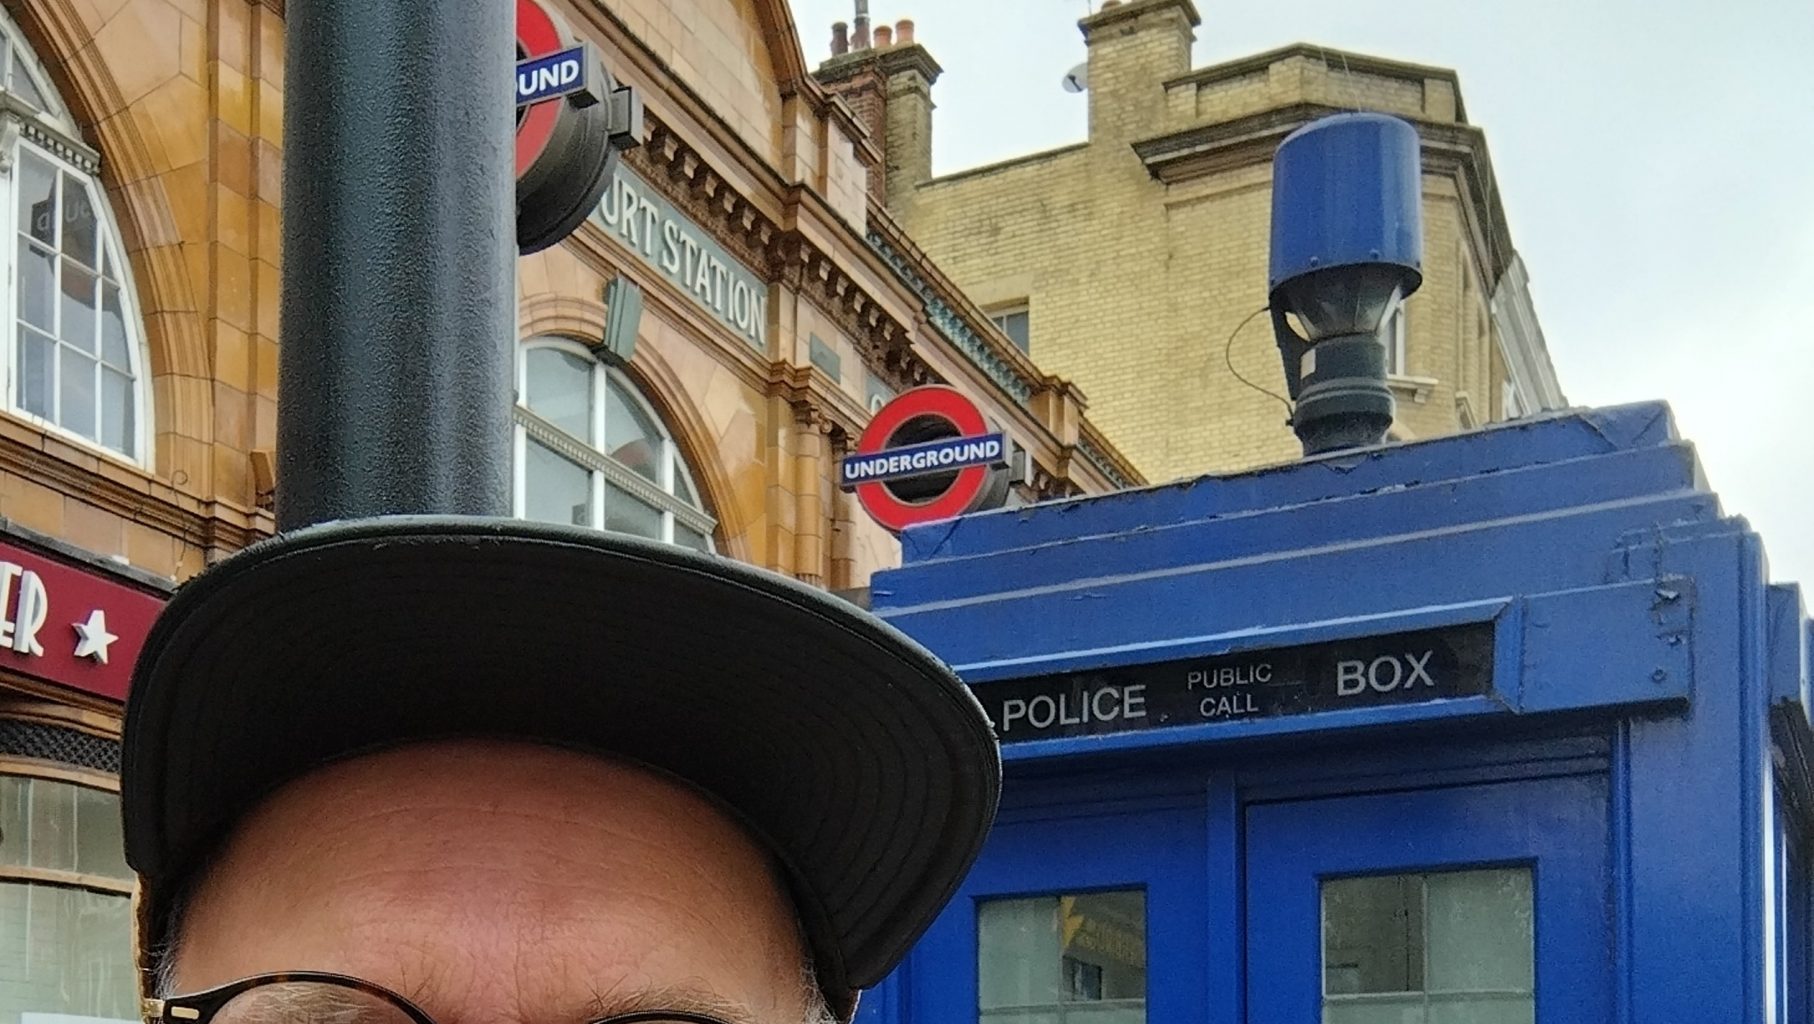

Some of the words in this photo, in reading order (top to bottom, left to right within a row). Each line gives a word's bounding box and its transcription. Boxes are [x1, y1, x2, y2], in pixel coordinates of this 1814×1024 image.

[517, 60, 579, 95] UND
[662, 219, 768, 346] STATION
[845, 440, 1000, 479] UNDERGROUND
[1187, 663, 1272, 690] PUBLIC
[1337, 650, 1435, 696] BOX
[1003, 684, 1147, 732] POLICE
[1200, 693, 1259, 717] CALL
